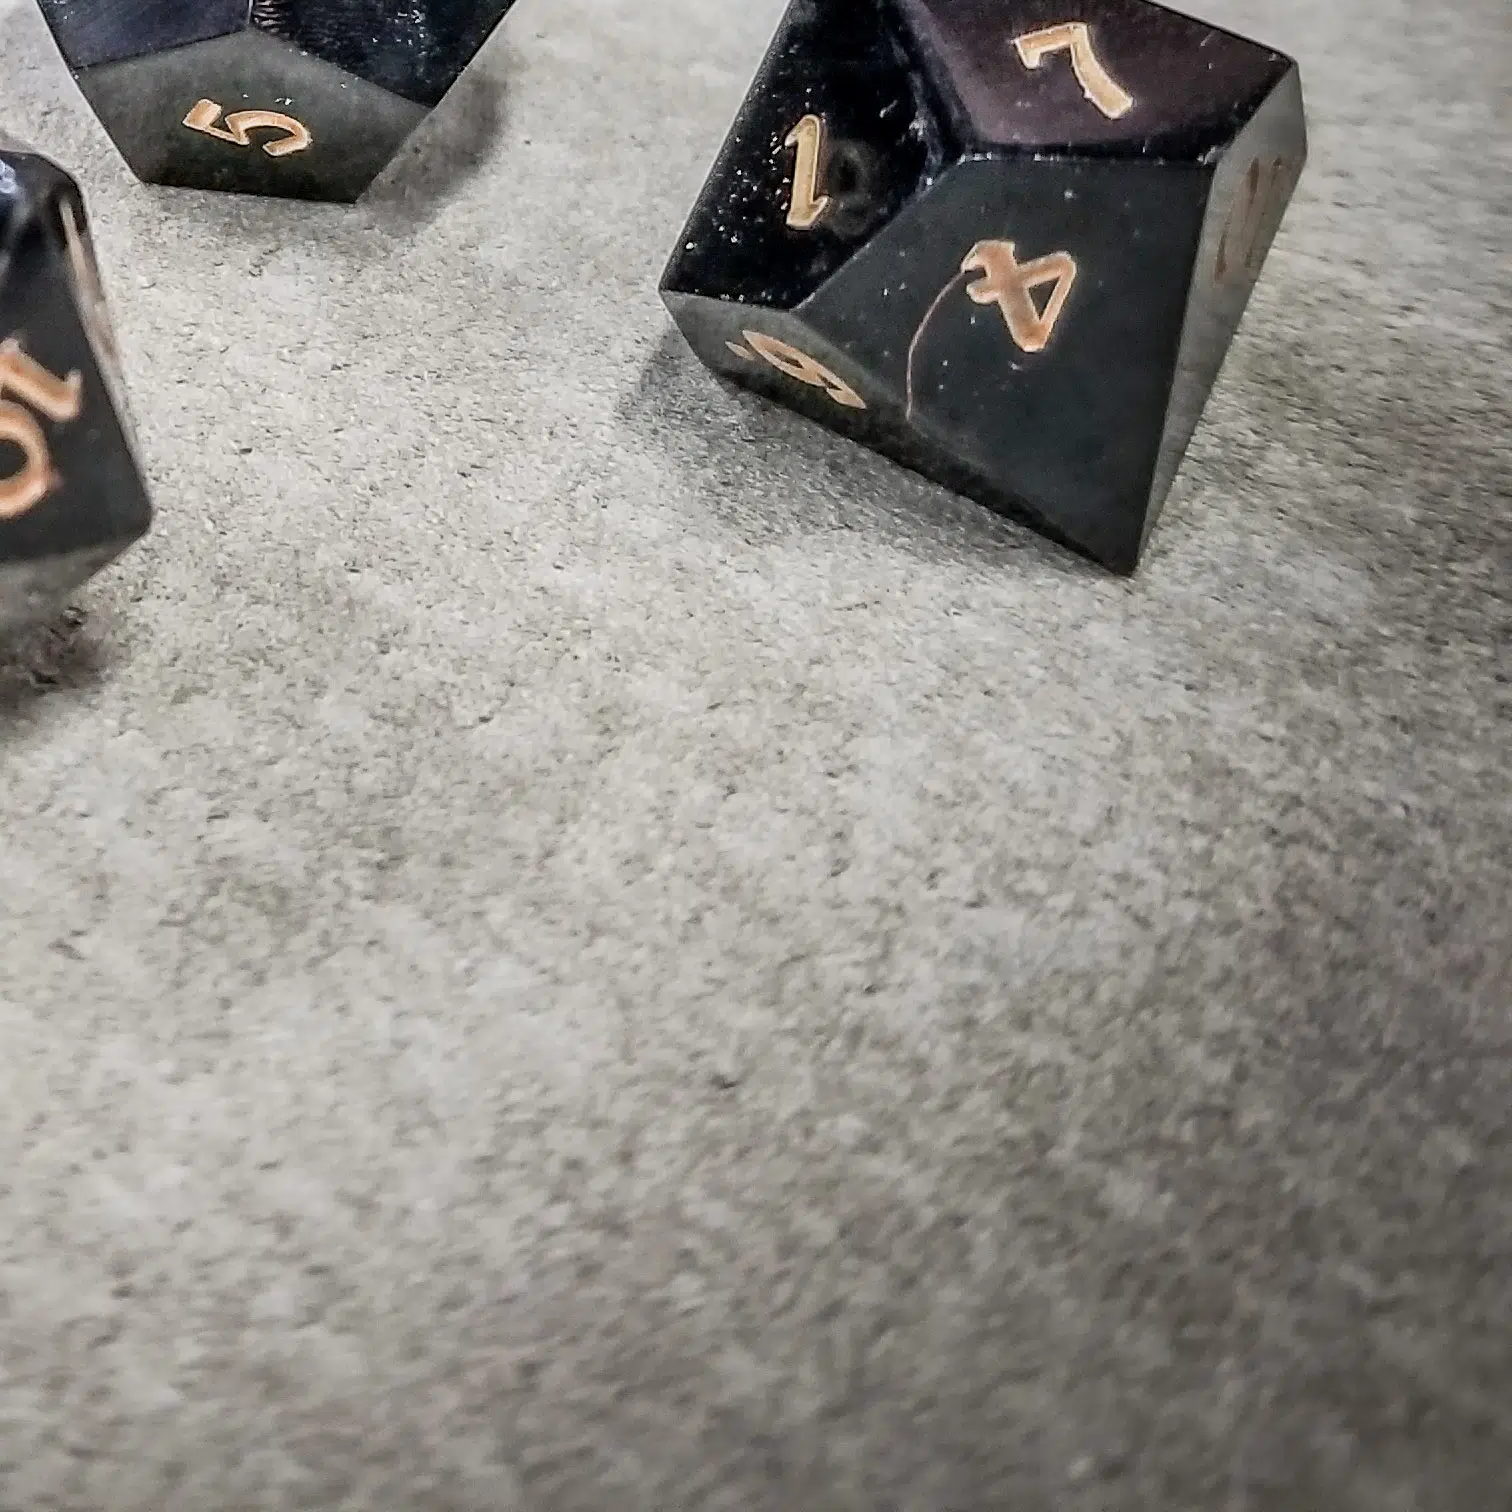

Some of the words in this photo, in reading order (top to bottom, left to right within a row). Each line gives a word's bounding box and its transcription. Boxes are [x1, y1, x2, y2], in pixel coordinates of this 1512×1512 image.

[1012, 20, 1135, 121] 7
[181, 97, 314, 158] 5
[783, 112, 829, 231] 1
[960, 238, 1079, 354] 4
